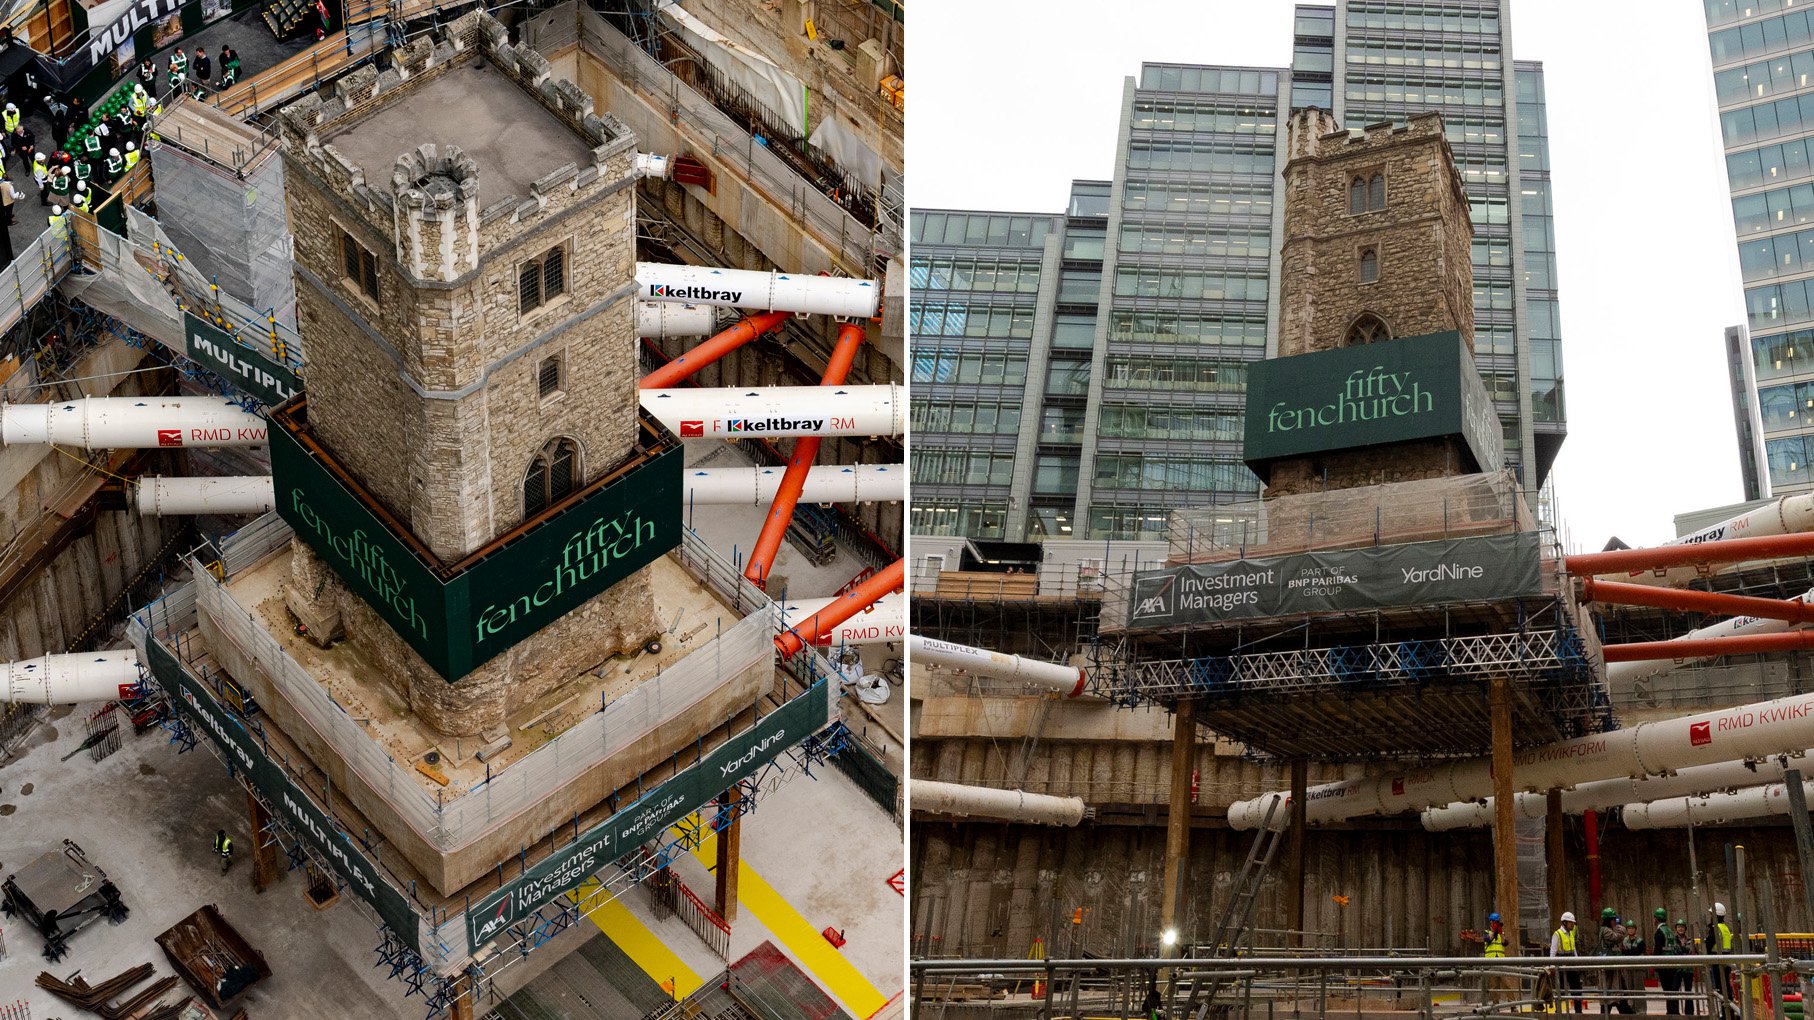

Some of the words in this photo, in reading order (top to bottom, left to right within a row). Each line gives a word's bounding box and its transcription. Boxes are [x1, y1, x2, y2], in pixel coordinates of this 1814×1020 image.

[665, 284, 742, 303] keltbray
[1345, 366, 1411, 400] fifty
[1267, 381, 1434, 433] fenchurch
[191, 428, 231, 441] RMD
[743, 417, 824, 431] keltbray
[562, 509, 634, 569] fifty
[291, 488, 427, 640] fenchurch
[353, 529, 407, 595] fifty
[1301, 567, 1328, 577] PART
[1330, 566, 1345, 575] OF
[1402, 563, 1484, 584] YardNine
[476, 516, 656, 644] fenchurch
[1181, 569, 1274, 592] Investment
[1288, 578, 1310, 588] BNP
[1311, 575, 1358, 586] PARIBAS
[1303, 587, 1342, 597] GROUP
[1136, 596, 1166, 613] AXA
[1180, 591, 1258, 611] Managers
[841, 627, 880, 640] RMD
[923, 640, 979, 656] MULTIPLEX
[192, 696, 254, 770] keltbray
[1718, 713, 1754, 731] RMD
[720, 729, 785, 778] YardNine
[1538, 740, 1607, 763] KWIKFORM
[1311, 786, 1347, 800] keltbray
[622, 821, 643, 838] BNP
[644, 794, 685, 824] PARIBAS
[634, 804, 659, 823] PART
[660, 794, 673, 807] OF
[637, 811, 671, 836] GROUP
[283, 791, 376, 899] MULTIPLEX
[519, 834, 610, 898] Investment
[519, 856, 595, 910] Managers
[477, 914, 507, 939] AXA
